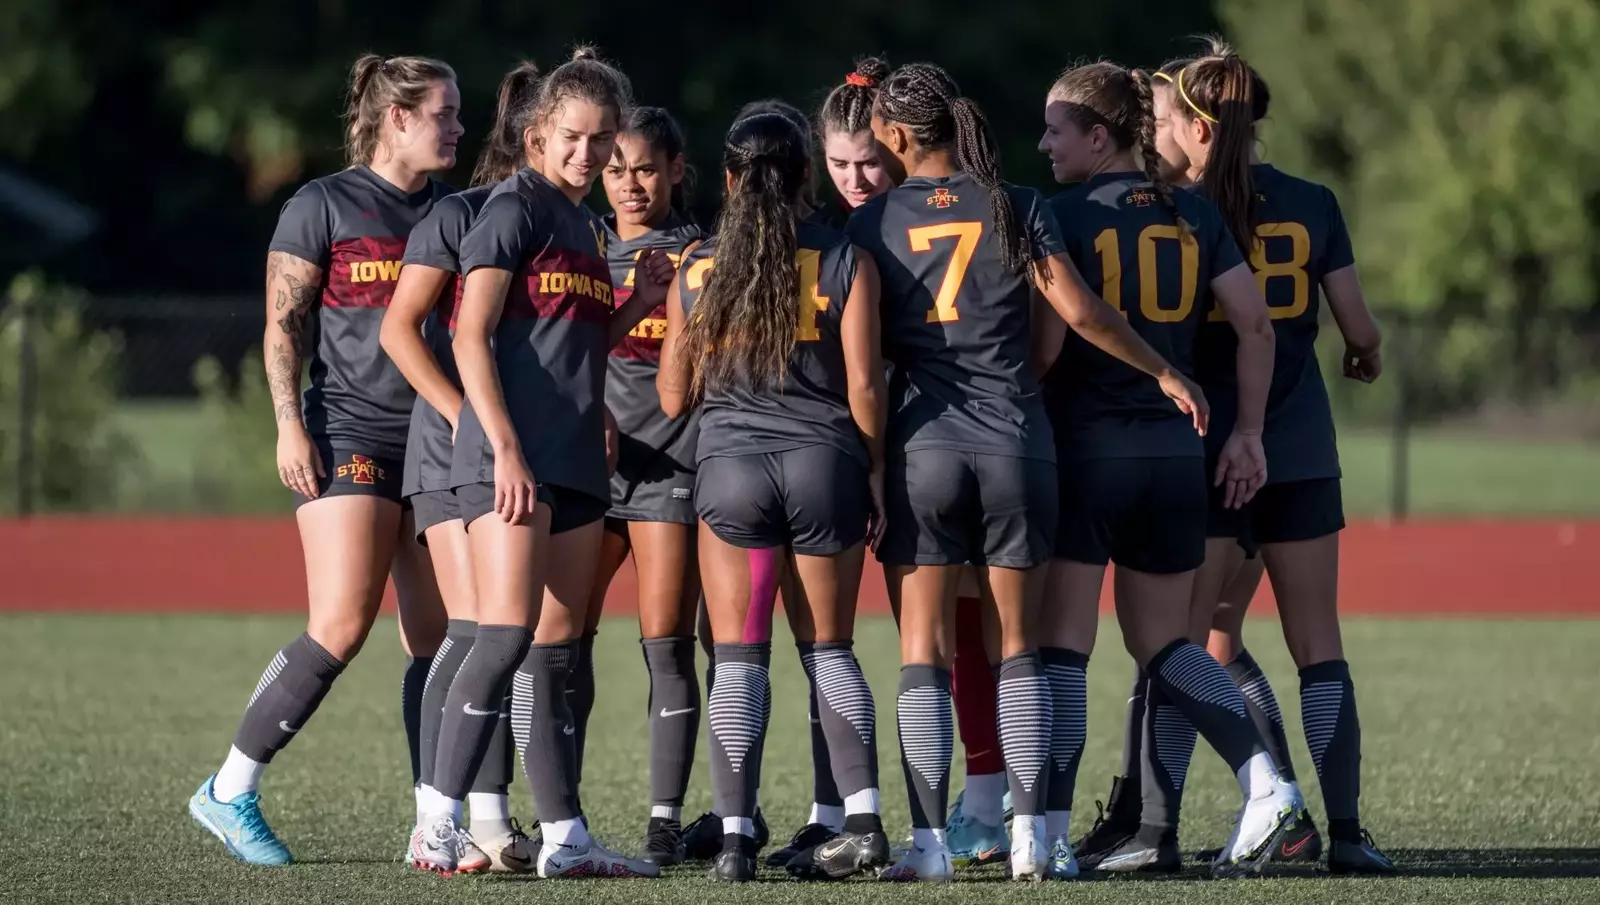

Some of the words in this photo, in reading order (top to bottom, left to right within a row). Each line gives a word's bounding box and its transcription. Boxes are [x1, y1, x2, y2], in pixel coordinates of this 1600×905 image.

[926, 194, 959, 205] STATE
[1125, 193, 1157, 204] STATE
[907, 221, 983, 324] 7
[1094, 223, 1200, 323] 10
[538, 272, 593, 298] IOWA
[628, 317, 668, 339] TE
[337, 462, 386, 481] STATE
